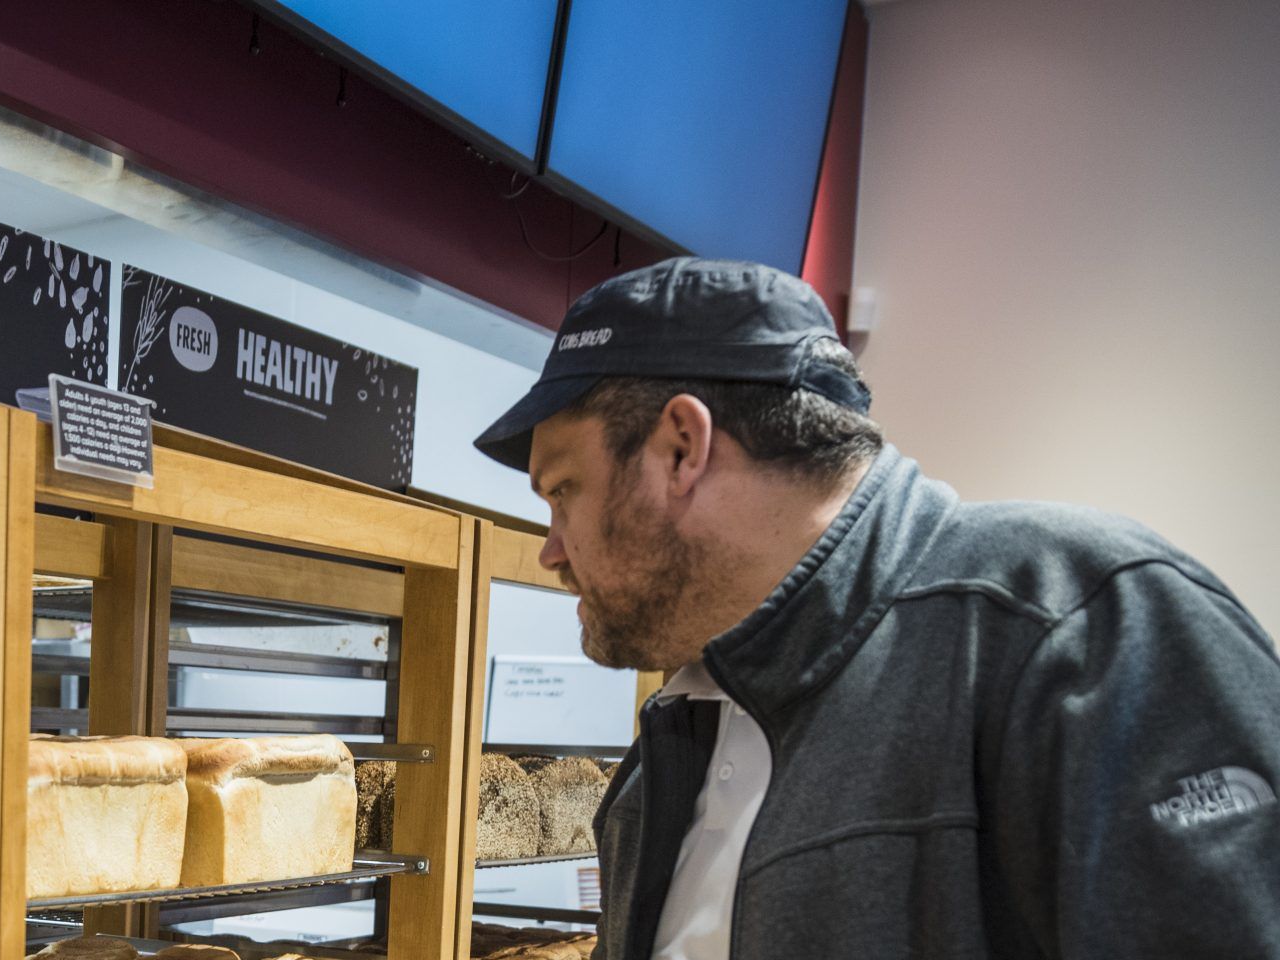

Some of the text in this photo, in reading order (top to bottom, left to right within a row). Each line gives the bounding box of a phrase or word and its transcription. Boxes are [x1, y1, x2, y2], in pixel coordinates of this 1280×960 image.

[176, 323, 211, 356] FRESH
[236, 327, 338, 406] HEALTHY
[77, 403, 92, 414] need
[101, 410, 123, 422] average
[130, 406, 141, 415] and
[66, 412, 89, 424] calories
[109, 422, 119, 431] and
[120, 424, 142, 436] children
[81, 437, 103, 449] calories
[95, 430, 110, 439] need
[119, 435, 140, 448] average
[1177, 768, 1225, 793] THE
[1150, 783, 1232, 821] NORTH
